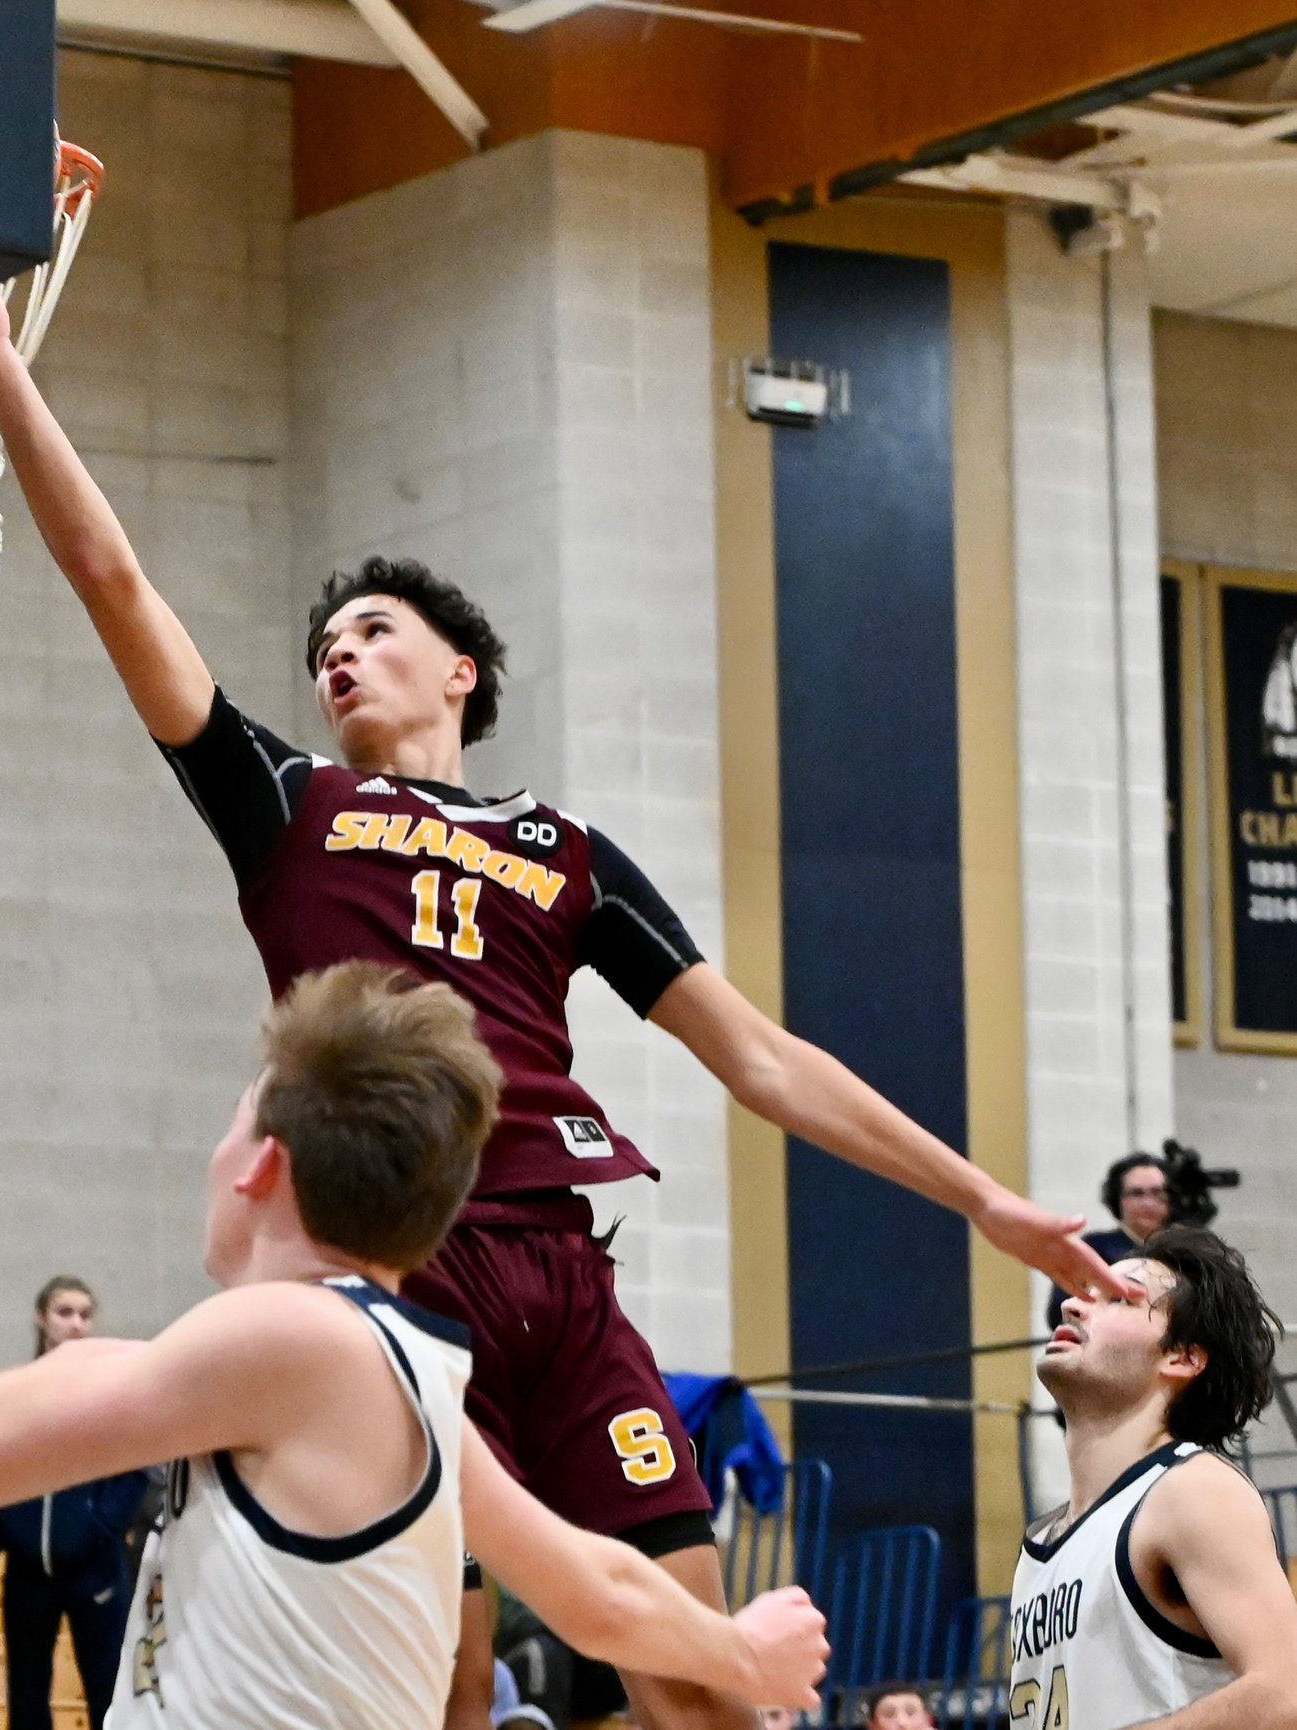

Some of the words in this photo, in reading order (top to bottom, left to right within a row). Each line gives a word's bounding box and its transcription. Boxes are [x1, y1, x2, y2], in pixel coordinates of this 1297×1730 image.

[324, 810, 566, 912] SHARON
[517, 821, 558, 847] DD
[411, 870, 484, 961] 11
[607, 1406, 676, 1487] S
[1011, 1577, 1083, 1667] OXBORO
